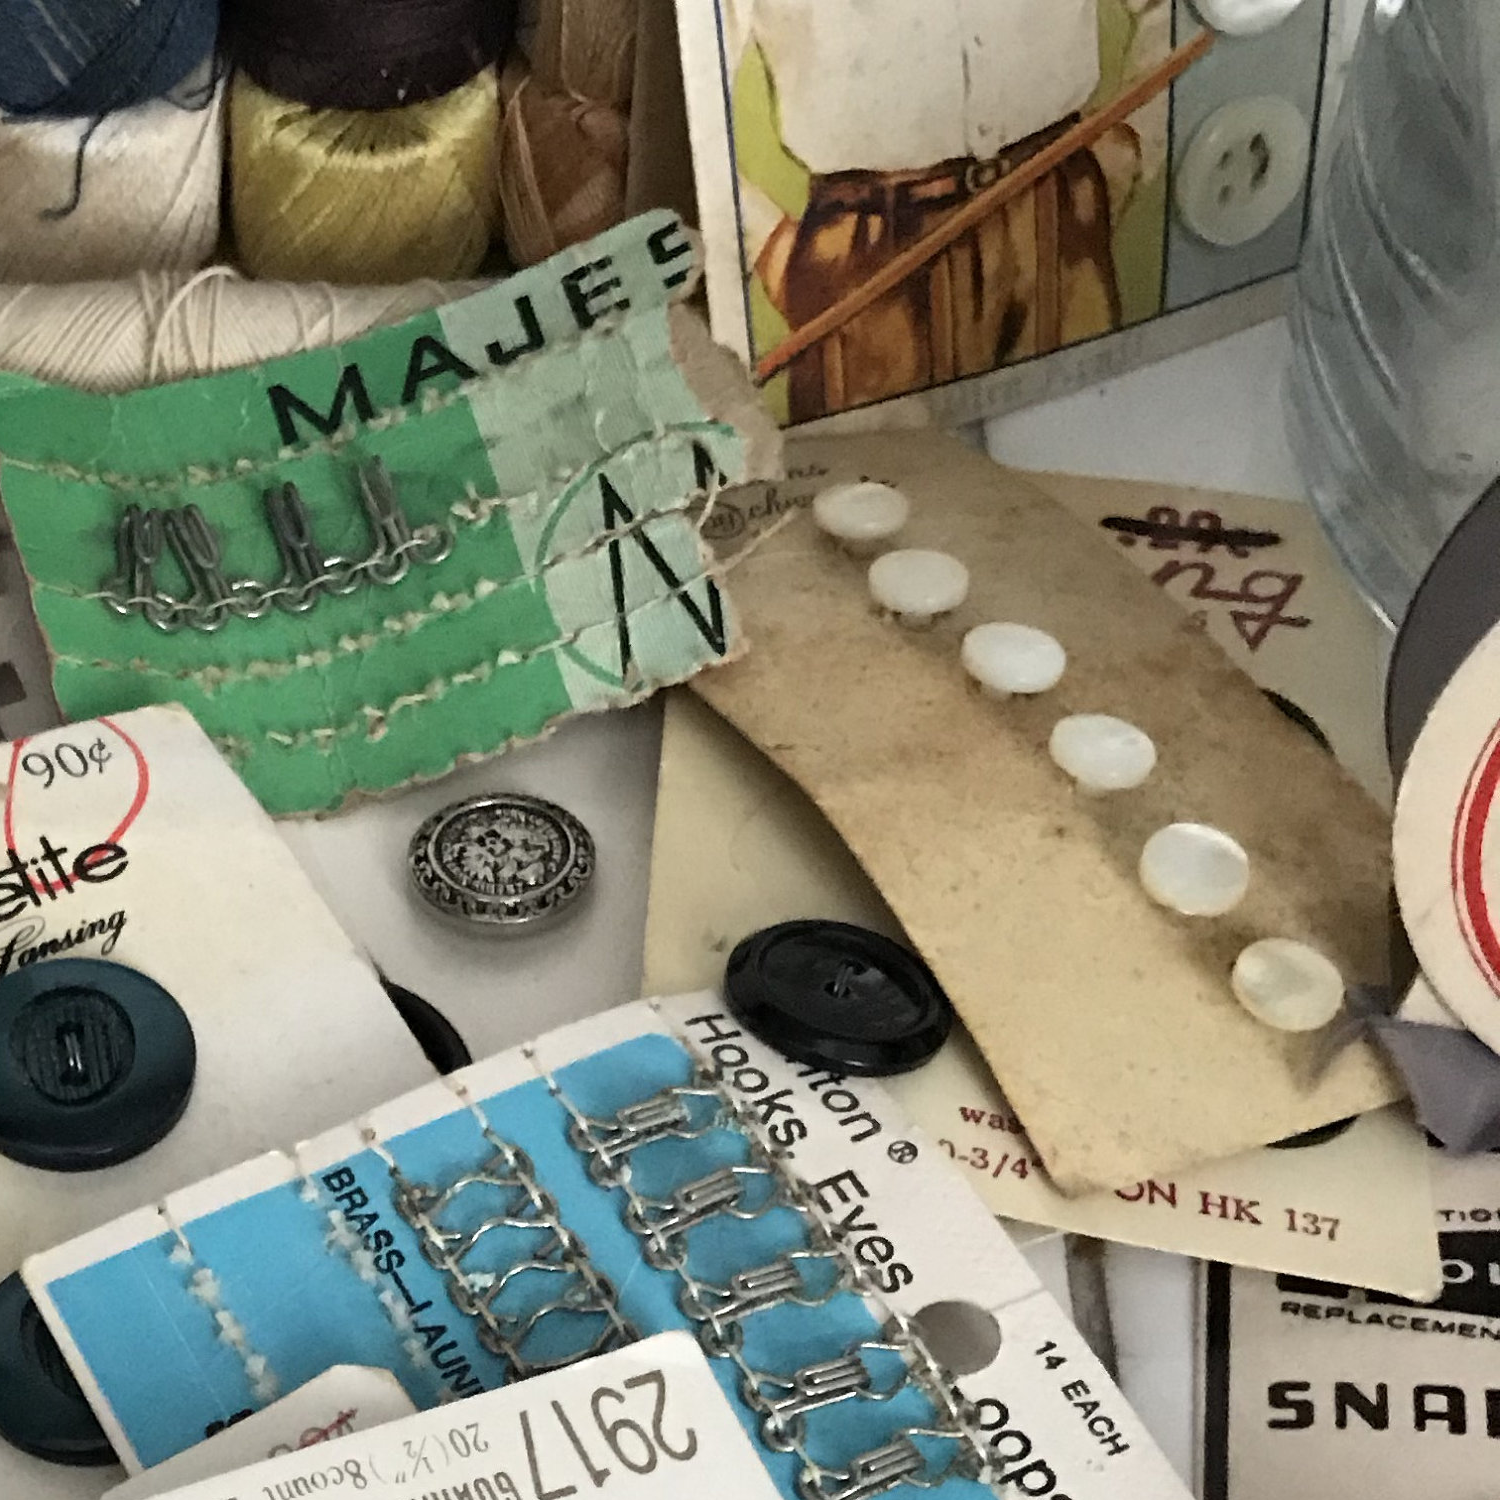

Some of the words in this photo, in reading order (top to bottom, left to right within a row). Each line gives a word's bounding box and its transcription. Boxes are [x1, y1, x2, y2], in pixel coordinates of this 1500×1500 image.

[1197, 1190, 1263, 1226] HK
[1284, 1208, 1341, 1242] 137
[1437, 1207, 1500, 1223] TIO
[1032, 1340, 1068, 1373] 14
[1061, 1379, 1131, 1459] EACH
